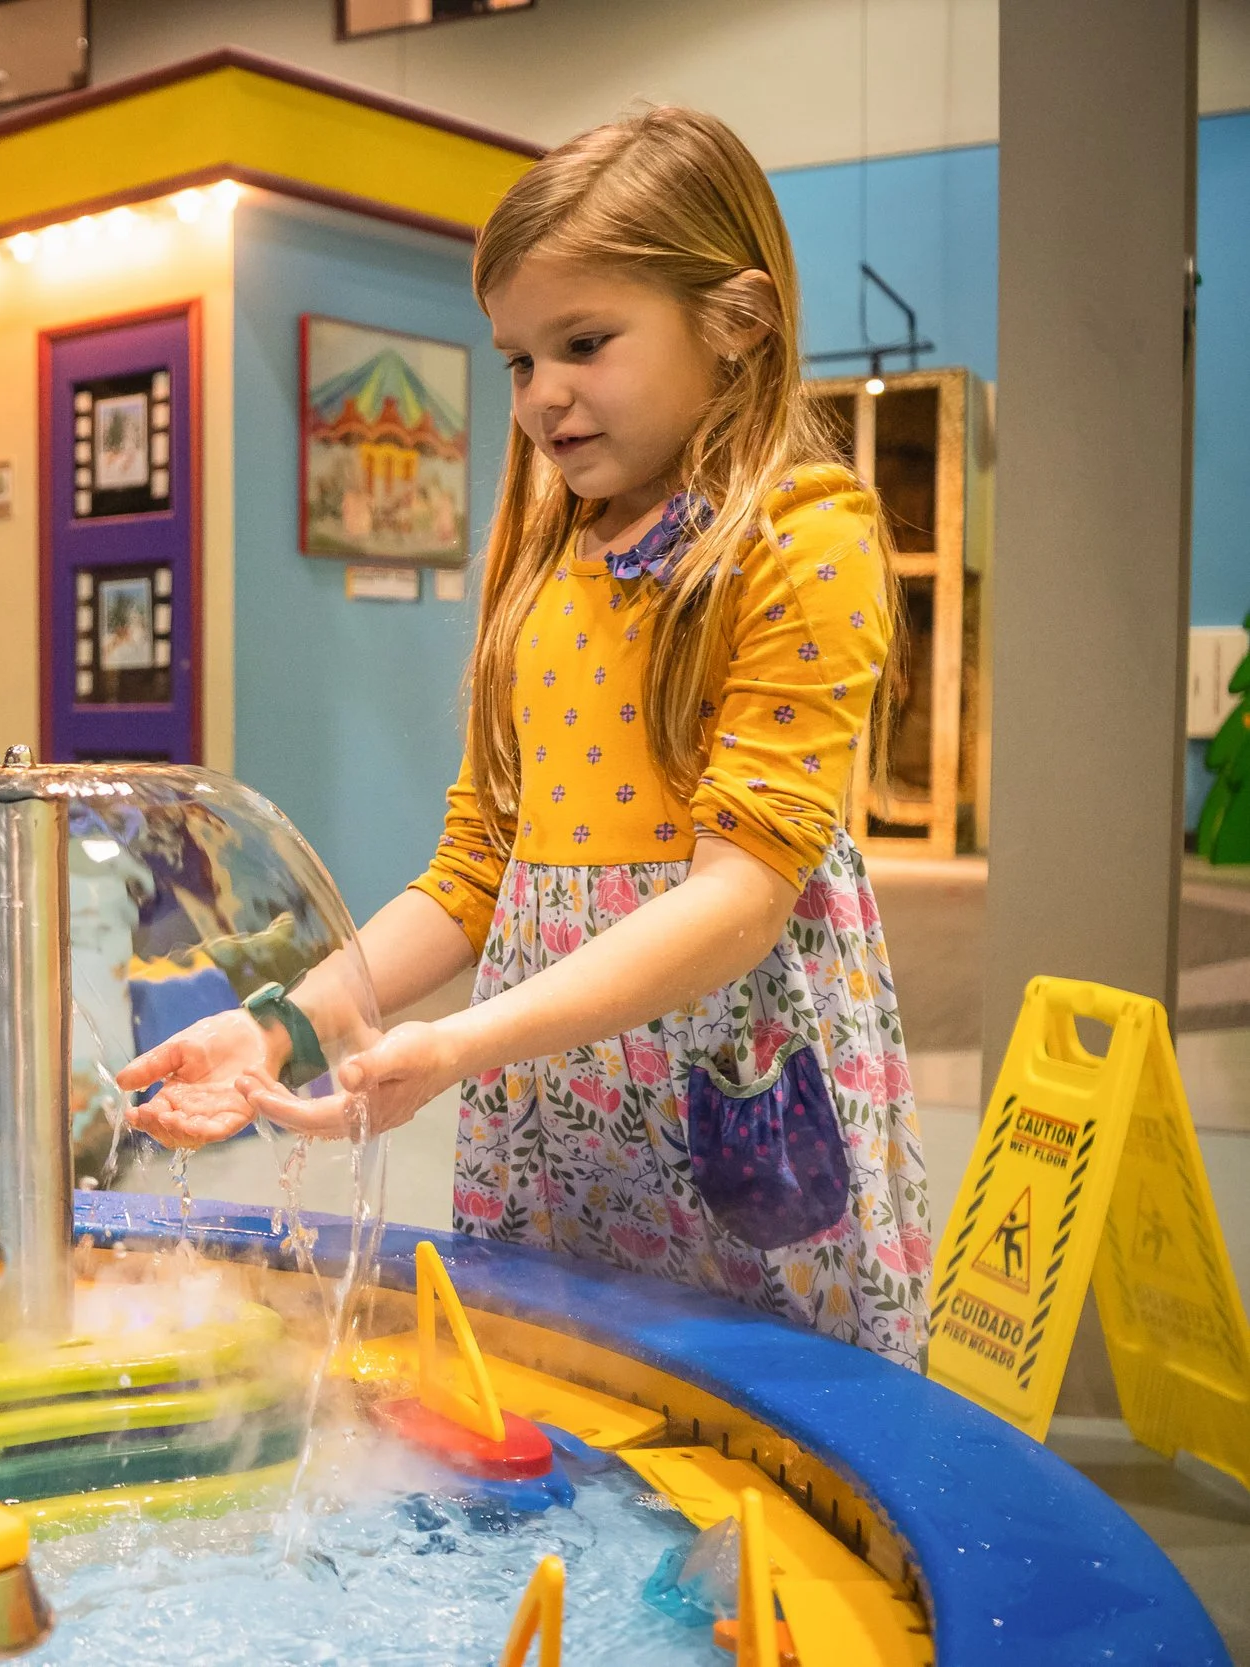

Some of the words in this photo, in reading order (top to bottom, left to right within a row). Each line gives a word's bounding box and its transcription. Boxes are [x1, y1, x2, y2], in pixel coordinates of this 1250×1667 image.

[1015, 1113, 1077, 1148] CAUTION
[1009, 1139, 1031, 1156] WET
[1034, 1147, 1068, 1170] FLOOR
[950, 1296, 1025, 1346] CUIDADO
[942, 1321, 967, 1345] PISO
[967, 1333, 1016, 1371] MOJADO
